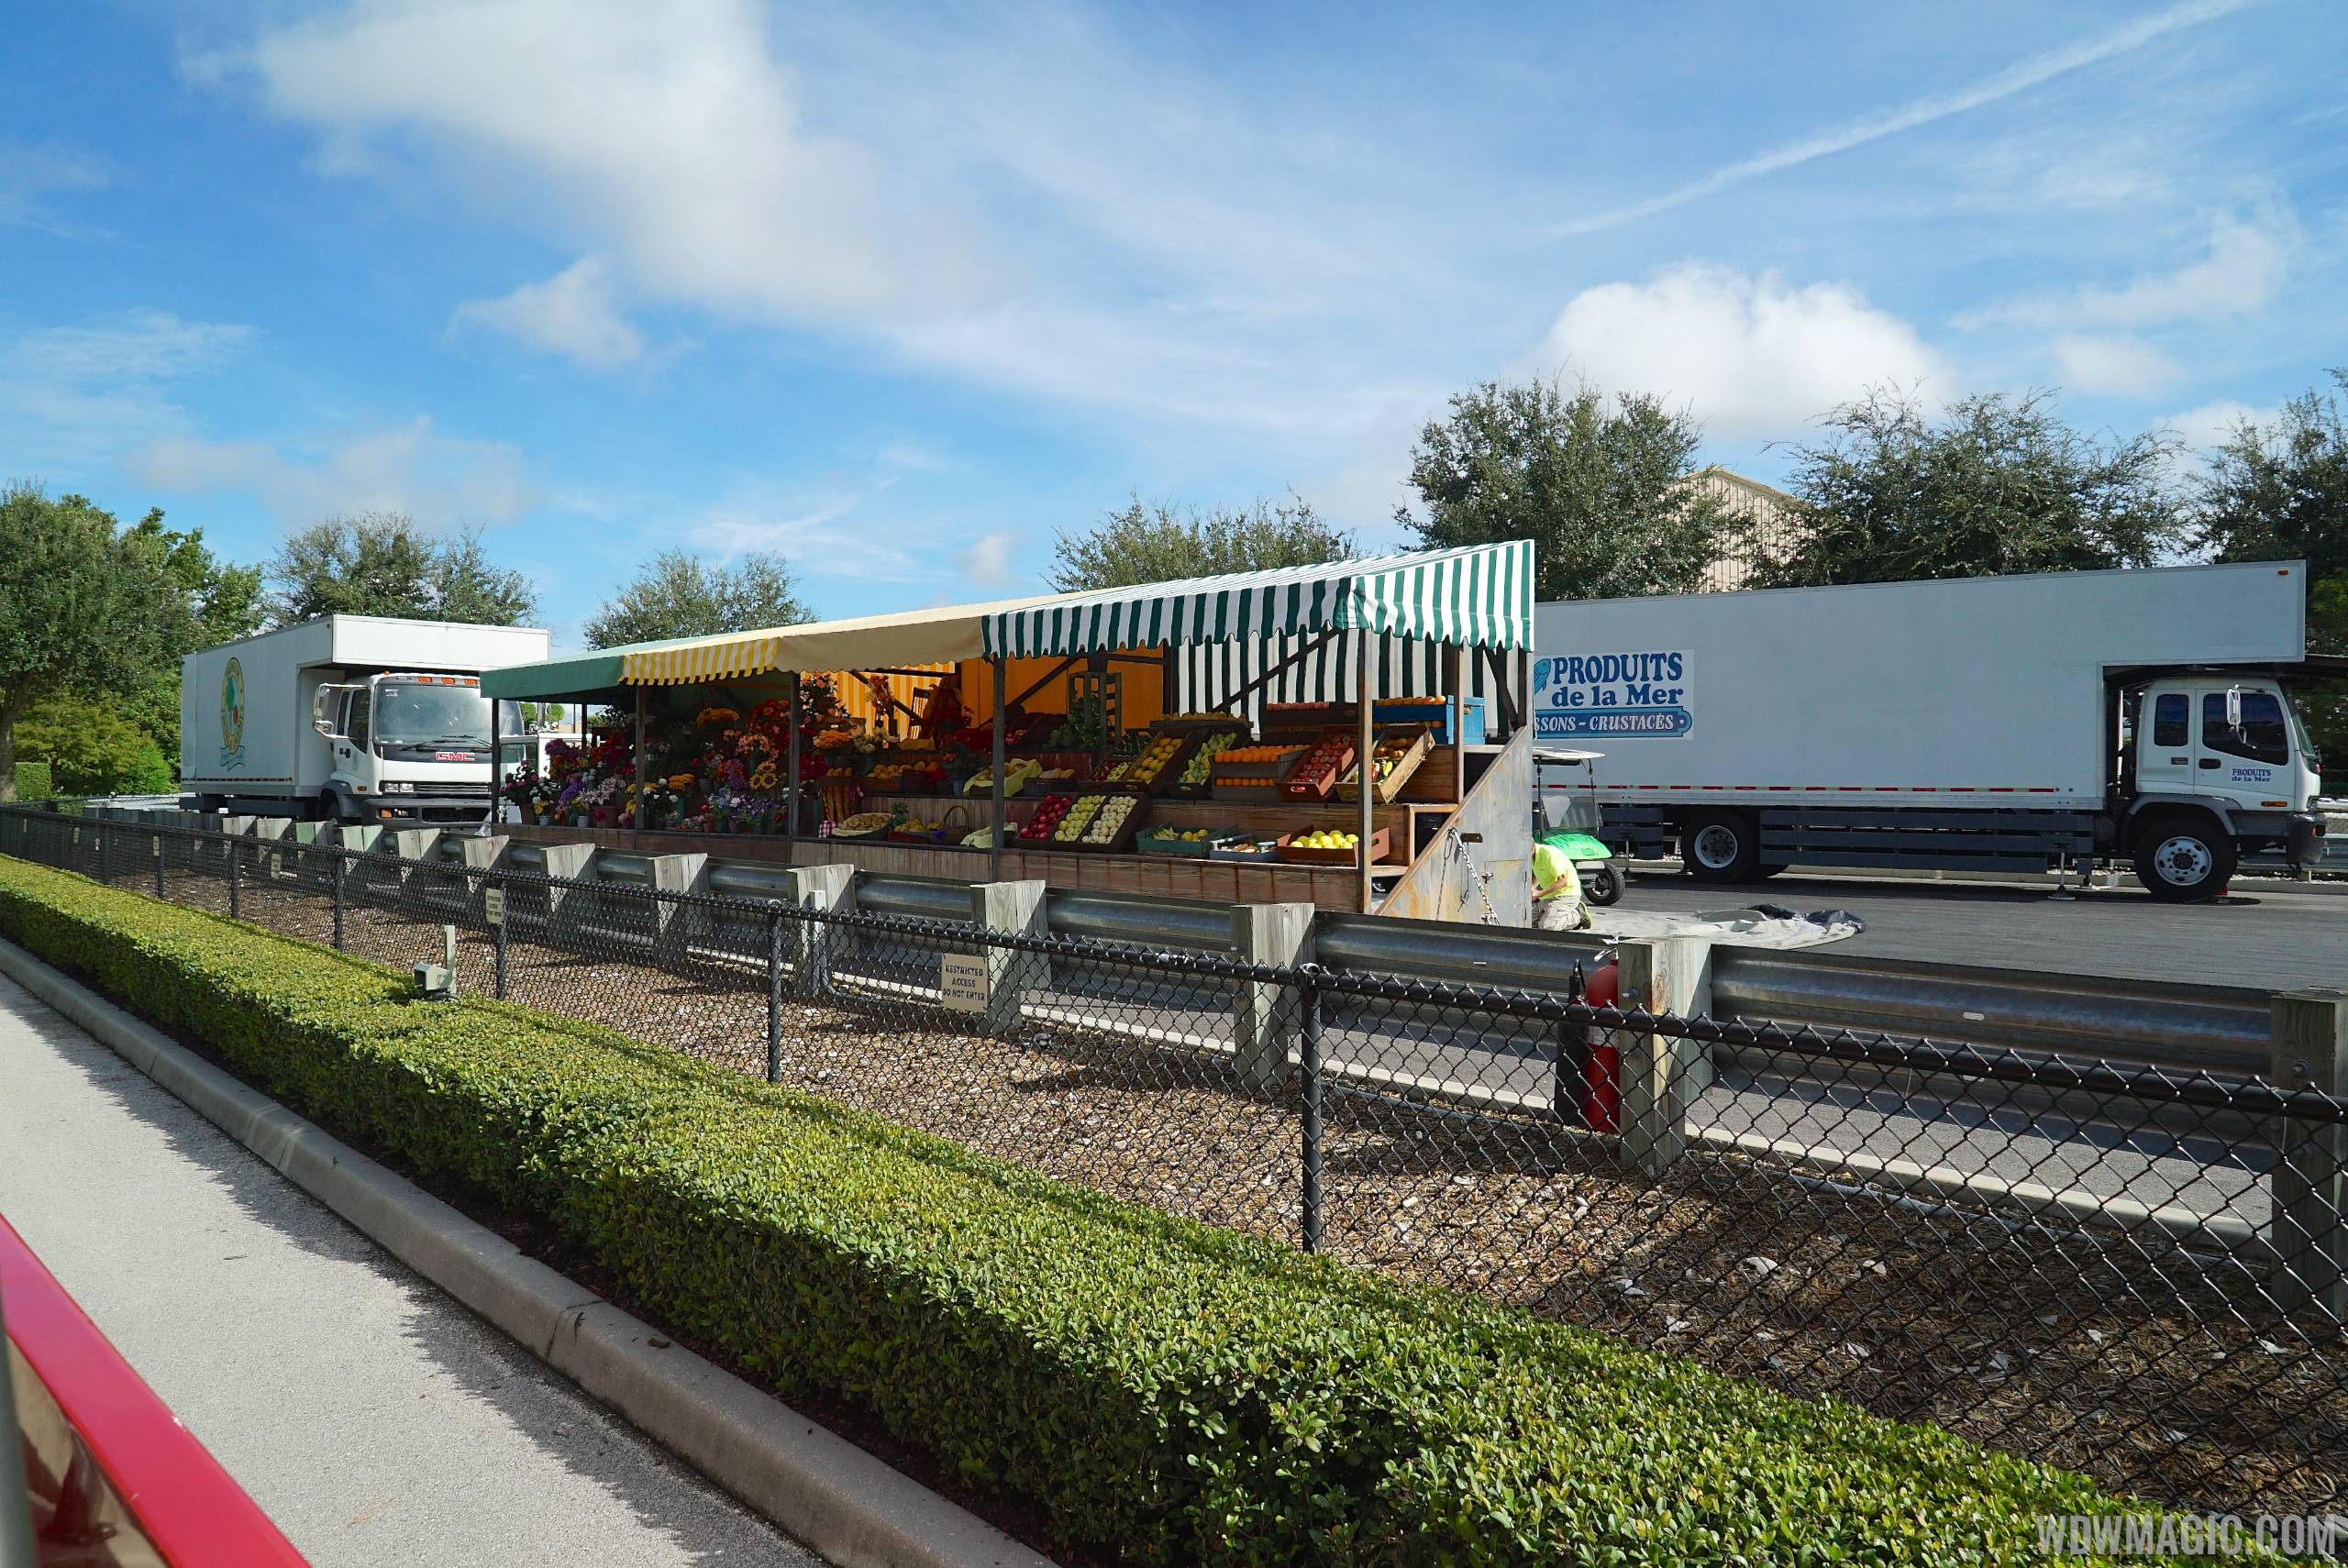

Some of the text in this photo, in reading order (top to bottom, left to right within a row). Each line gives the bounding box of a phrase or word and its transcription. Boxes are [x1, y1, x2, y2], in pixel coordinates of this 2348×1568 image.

[1552, 652, 1683, 685] PRODUITS
[1551, 683, 1684, 707] de la Mer
[436, 752, 475, 761] GMC
[945, 965, 983, 977] RESTRICTED
[951, 977, 976, 988] ACCESS
[942, 988, 985, 1000] DO NOT ENTER
